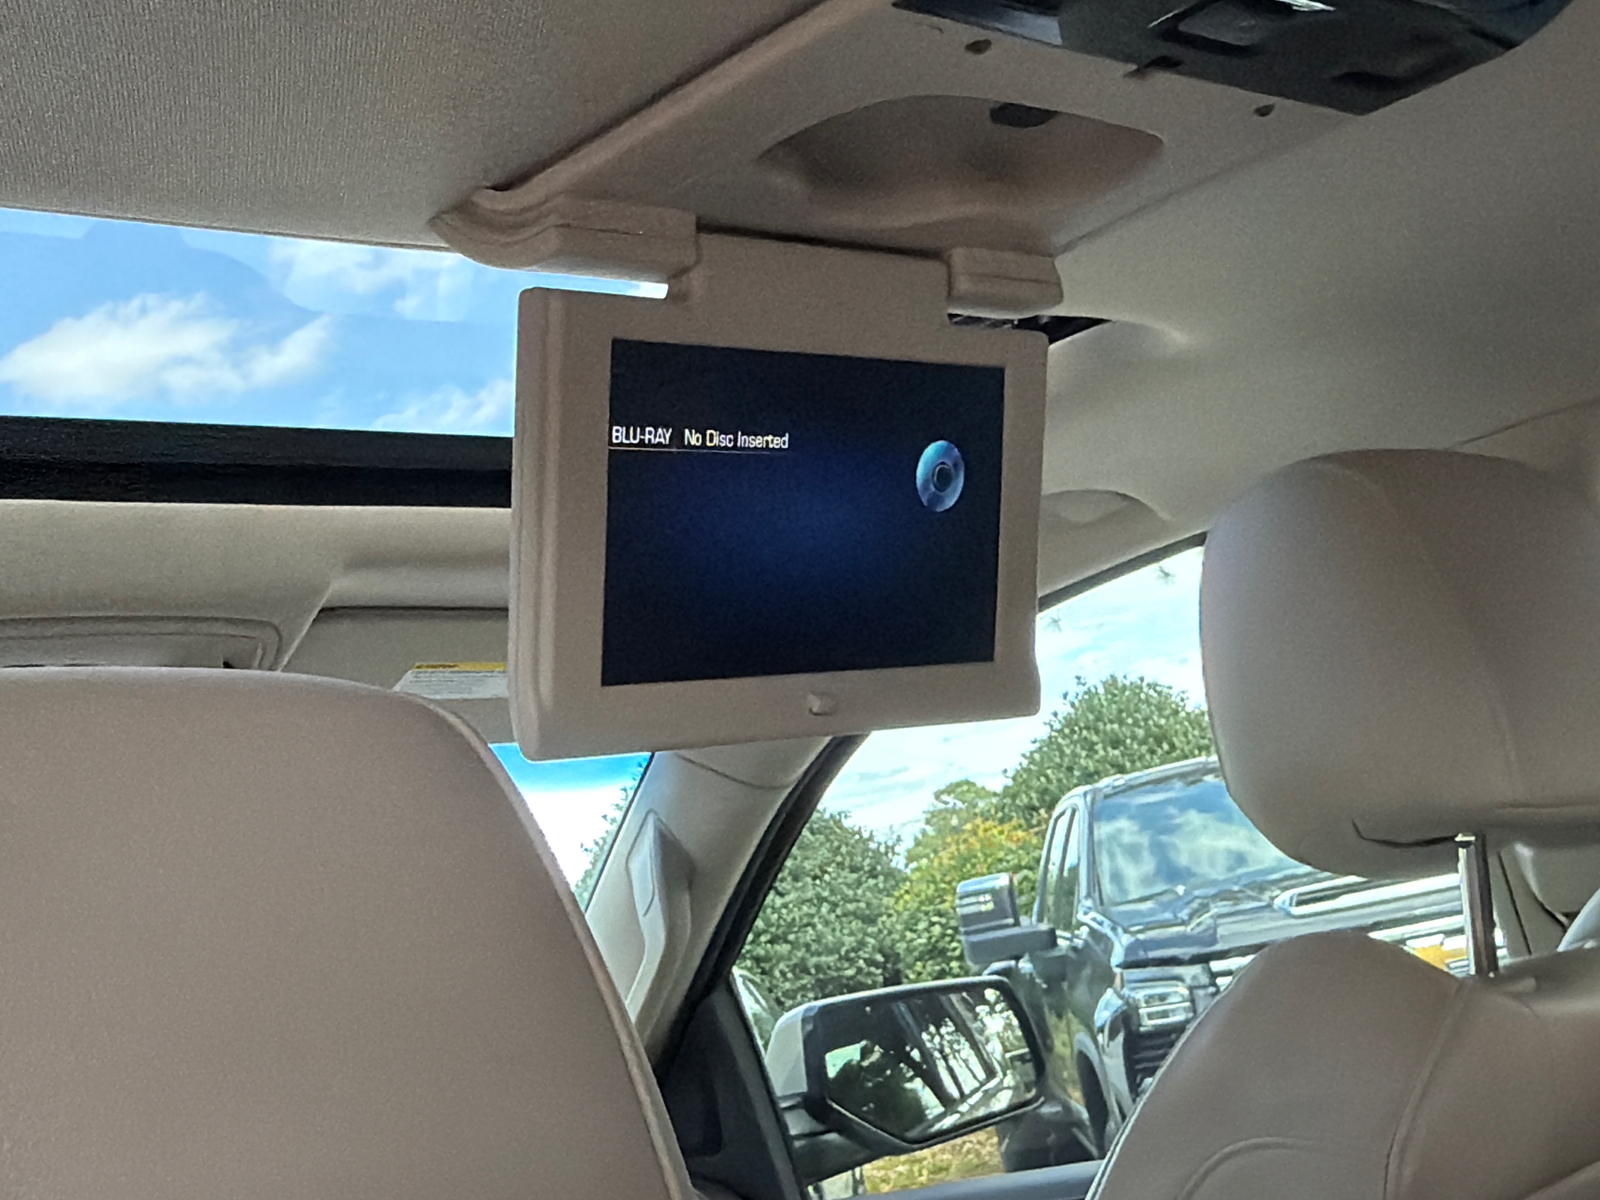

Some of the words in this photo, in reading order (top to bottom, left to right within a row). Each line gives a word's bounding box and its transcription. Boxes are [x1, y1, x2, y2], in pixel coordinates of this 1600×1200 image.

[611, 425, 673, 445] BLU-RAY
[684, 428, 702, 446] No
[705, 429, 734, 447] Disc
[736, 431, 789, 449] Inserted
